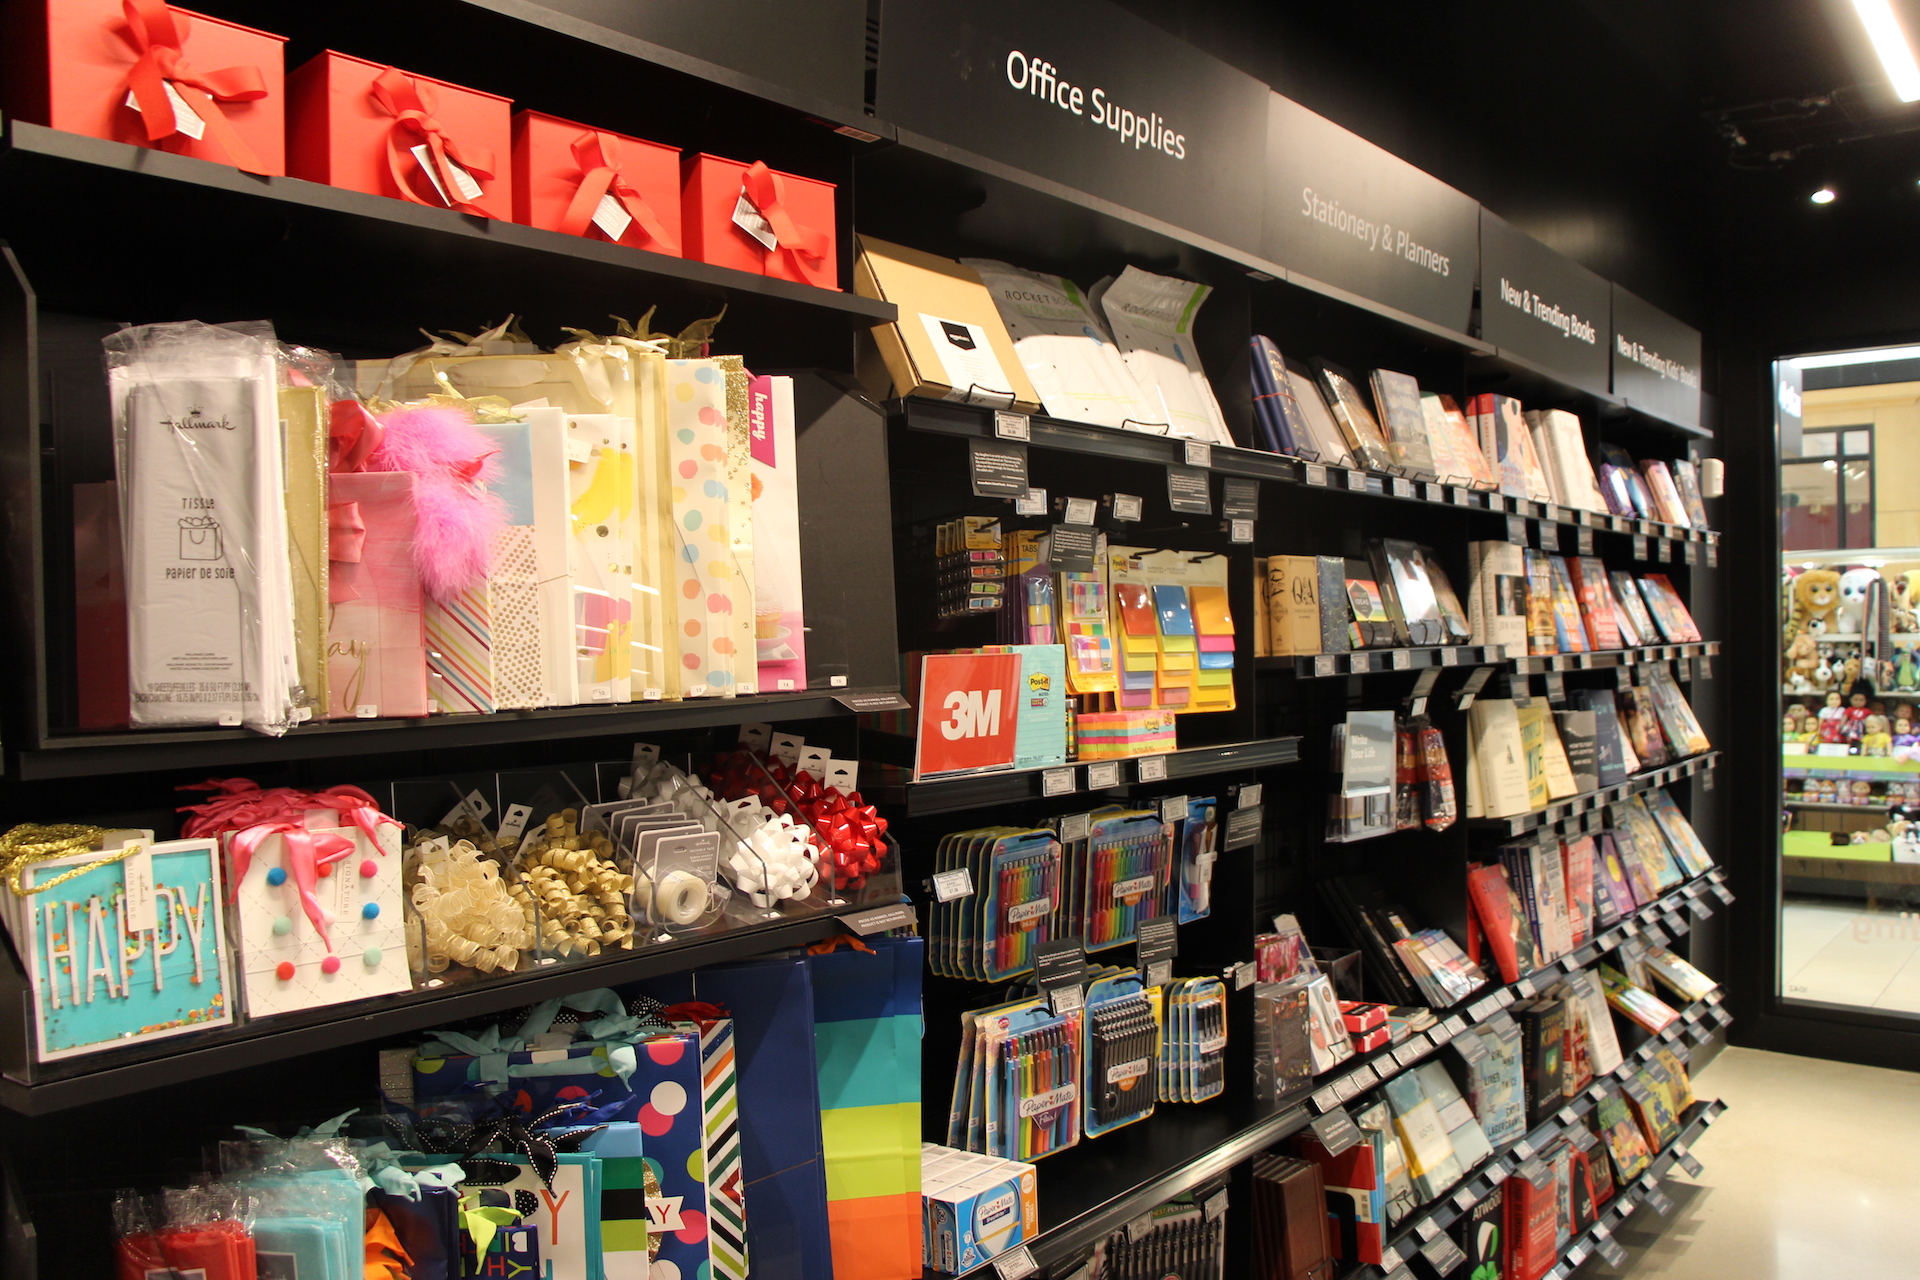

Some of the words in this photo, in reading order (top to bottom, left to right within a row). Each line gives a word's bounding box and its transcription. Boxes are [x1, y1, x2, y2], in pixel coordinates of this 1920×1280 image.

[1006, 49, 1084, 116] Office
[1090, 88, 1186, 160] Supplies
[1302, 186, 1380, 252] Stationery
[1382, 223, 1394, 252] &
[1396, 230, 1450, 277] Planners
[1016, 303, 1078, 319] EVERLAST
[1500, 277, 1521, 309] New
[1523, 289, 1531, 312] &
[1533, 294, 1570, 338] Trending
[1571, 313, 1596, 345] Books
[1617, 334, 1633, 358] New
[1633, 342, 1639, 362] &
[1639, 345, 1665, 380] Trending
[159, 414, 237, 434] Hallmark
[751, 391, 767, 442] happy
[1021, 544, 1038, 553] TABS
[1030, 677, 1049, 686] Post-it
[940, 689, 1002, 741] 3M
[1351, 734, 1368, 745] Write
[1350, 749, 1364, 759] Your
[1364, 746, 1376, 758] Life
[127, 860, 137, 919] SIGNATURE
[343, 860, 352, 916] SIGNATURE
[1114, 882, 1134, 895] Paper
[1139, 880, 1152, 889] Mate
[1010, 906, 1031, 921] Paper
[1034, 903, 1049, 915] Mate
[44, 882, 206, 1010] HAPPY
[1541, 1010, 1565, 1029] STEPHEN
[1541, 1024, 1565, 1047] KING
[1491, 1049, 1504, 1061] GIRL
[1110, 1067, 1129, 1081] Paper
[1132, 1064, 1146, 1074] Mate
[1484, 1072, 1500, 1086] LIVED
[1022, 1099, 1050, 1113] Paper
[1053, 1090, 1075, 1104] Mate
[978, 1204, 996, 1217] Paper
[1000, 1196, 1014, 1208] Mate
[1167, 1205, 1179, 1213] PEN
[1472, 1190, 1503, 1222] ATWOOD
